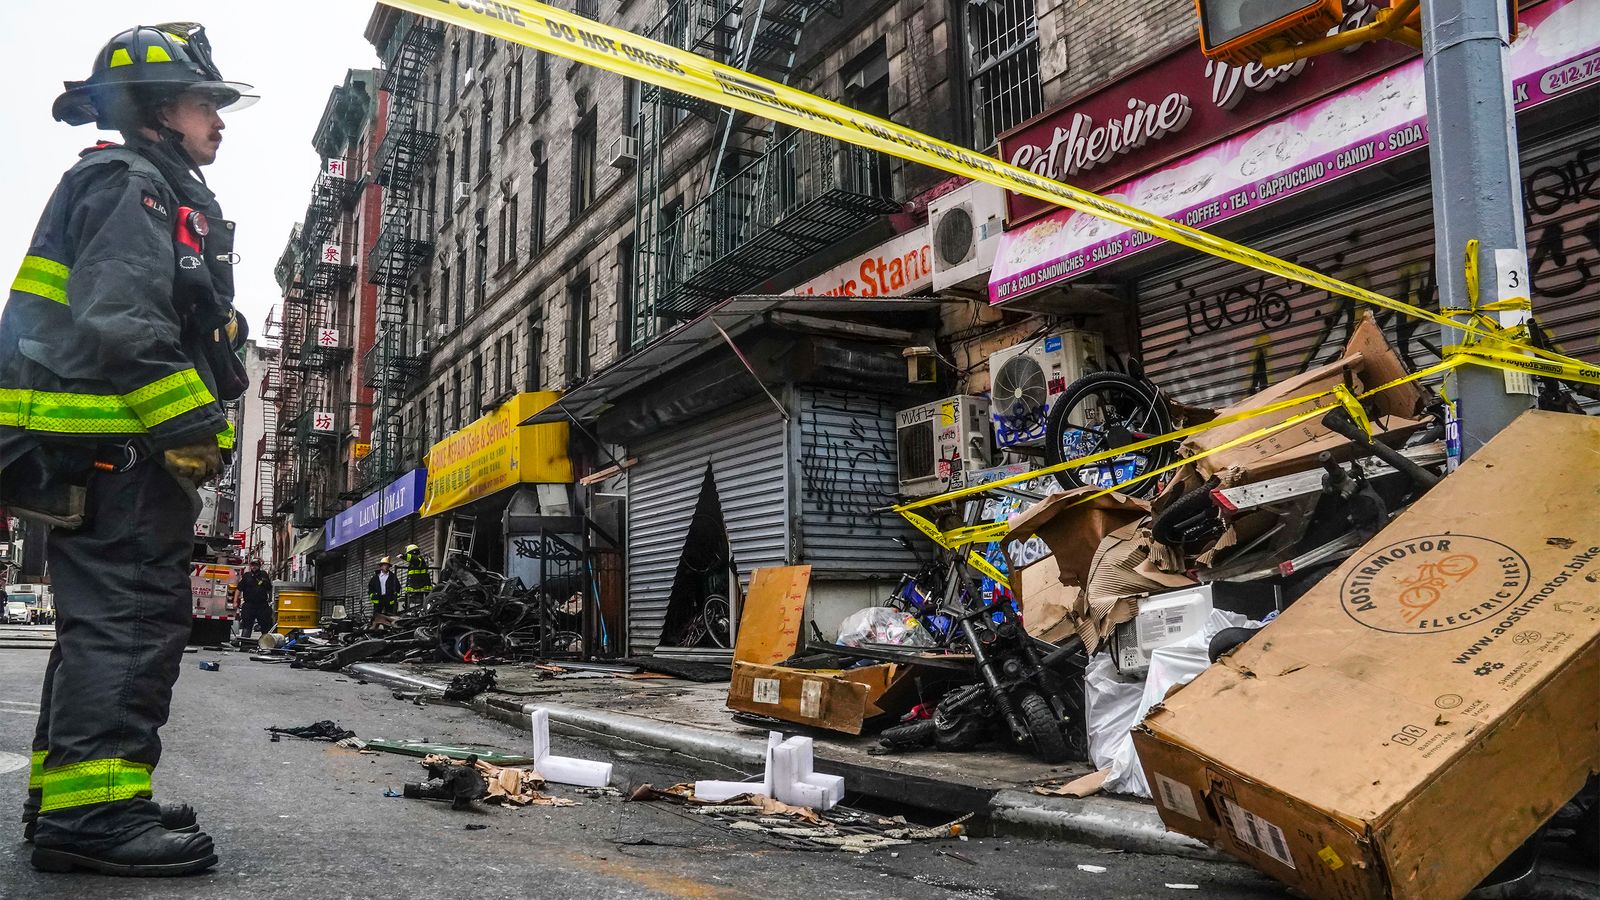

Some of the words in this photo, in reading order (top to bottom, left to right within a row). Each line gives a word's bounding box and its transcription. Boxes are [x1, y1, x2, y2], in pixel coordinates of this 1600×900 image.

[545, 18, 577, 43] DO
[577, 29, 620, 56] NOT
[620, 43, 687, 76] CROSS
[1010, 92, 1192, 197] Catherine
[329, 160, 345, 177] 利
[997, 282, 1011, 298] HOT
[1011, 280, 1018, 292] &
[1018, 273, 1036, 291] COLD
[1037, 254, 1085, 282] SANDWICHES
[1092, 239, 1124, 262] SALADS
[1186, 201, 1221, 227] COFFFE
[1229, 191, 1249, 211] TEA
[1258, 161, 1324, 199] CAPPUCCINO
[1336, 141, 1375, 170] CANDY
[1387, 124, 1423, 151] SODA
[1508, 270, 1519, 289] 3
[320, 330, 338, 346] 茶
[316, 414, 333, 431] 坊
[359, 487, 406, 528] LAUNDOMAT
[1349, 539, 1452, 613] AOSTIRMOTOR
[1418, 590, 1512, 629] ELECTRIC
[1498, 556, 1521, 588] BIKES
[1452, 545, 1600, 667] www.aostirmotor.bike
[1498, 661, 1528, 686] SHIMANO
[1417, 733, 1443, 751] Battery
[1422, 731, 1457, 759] Removable
